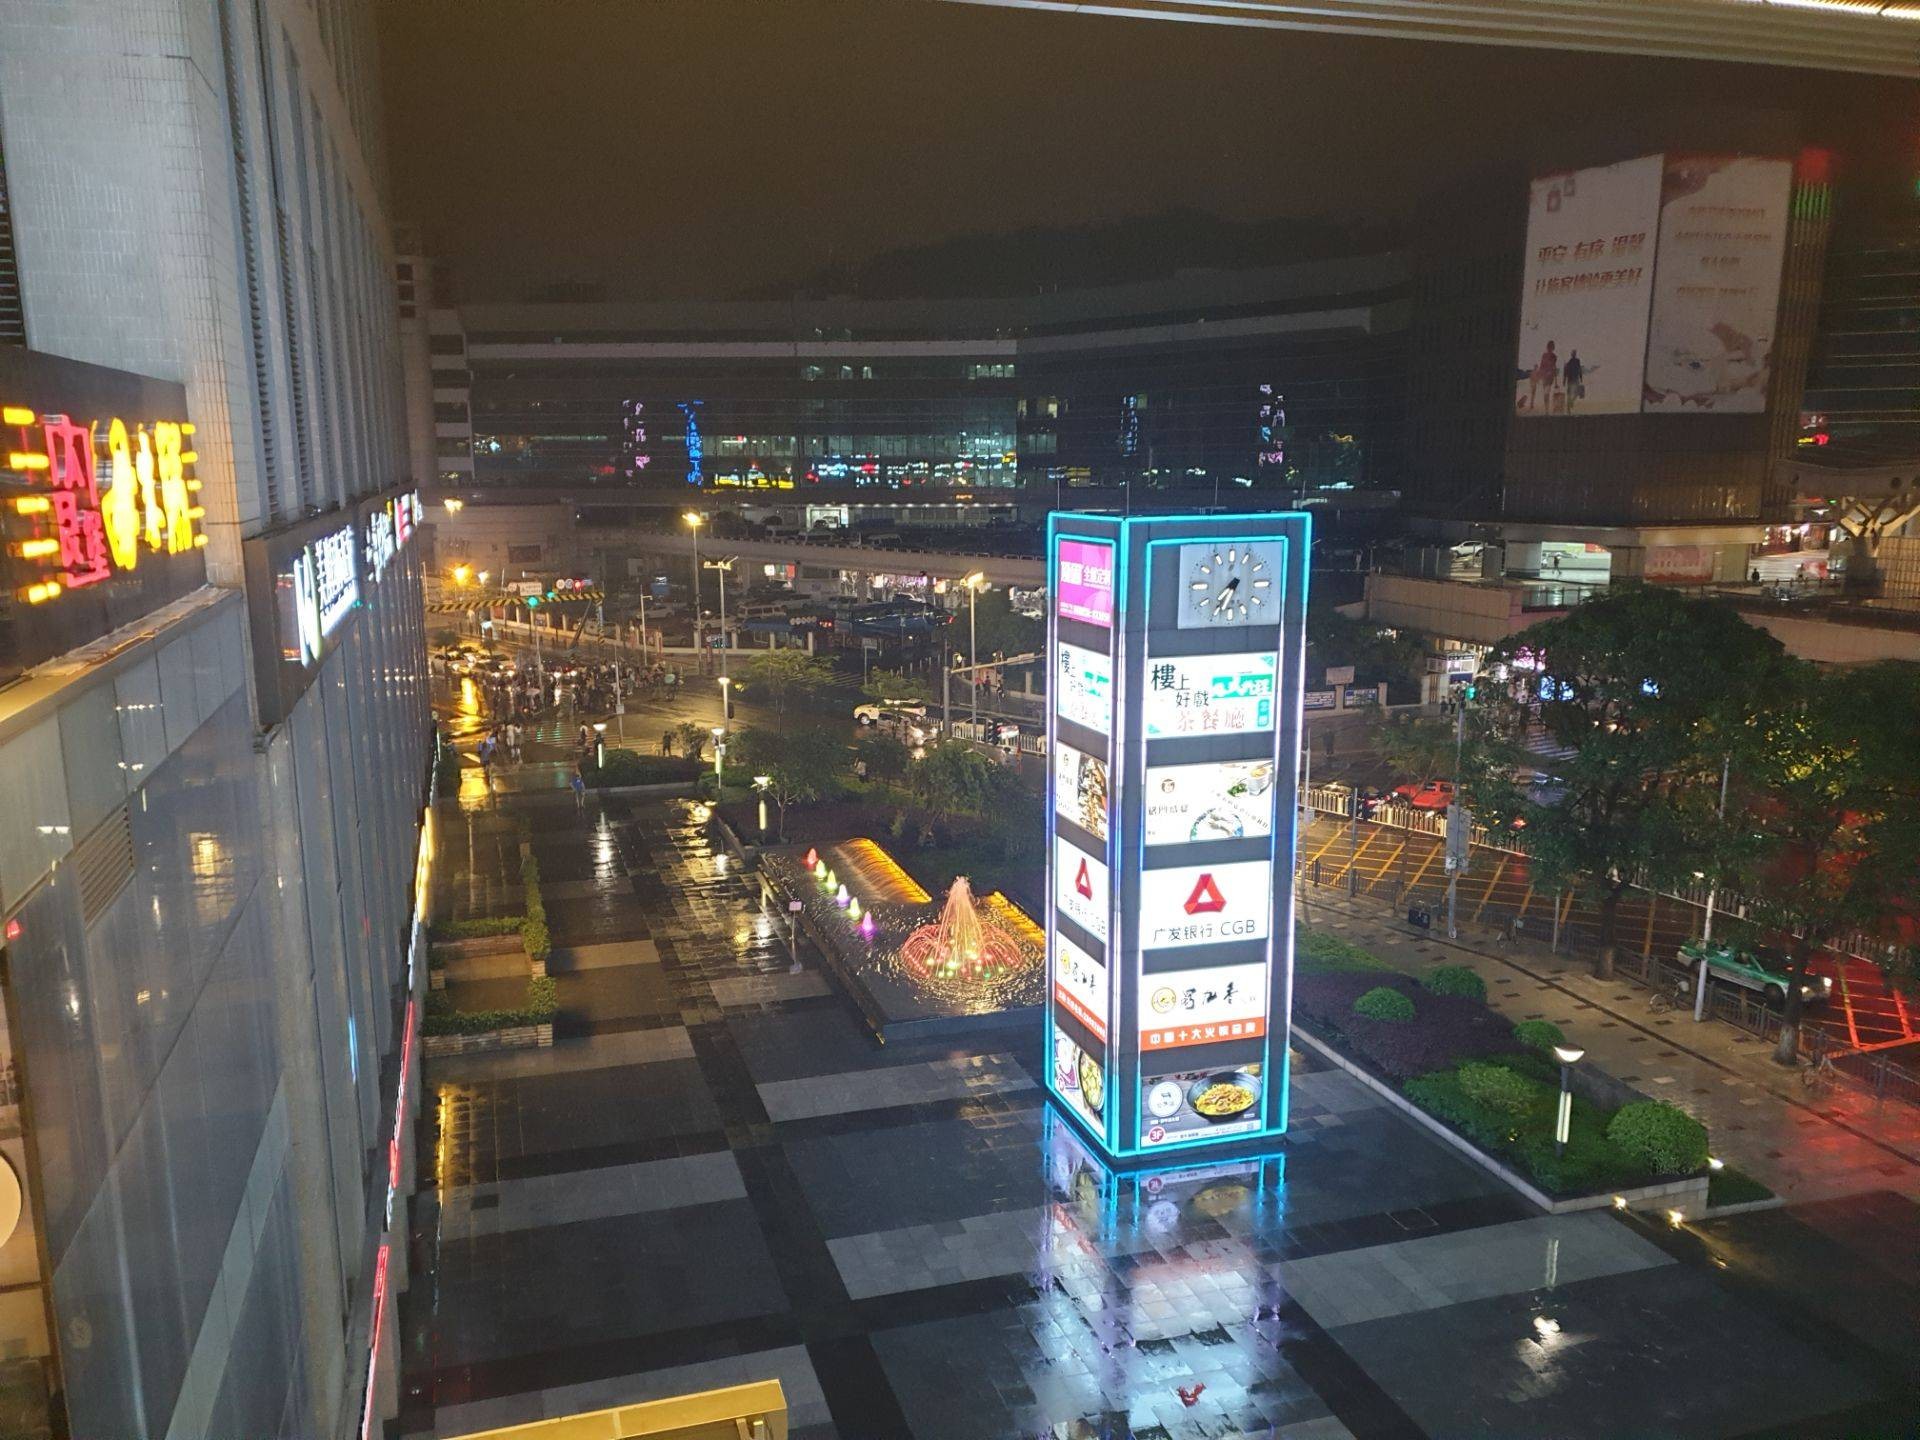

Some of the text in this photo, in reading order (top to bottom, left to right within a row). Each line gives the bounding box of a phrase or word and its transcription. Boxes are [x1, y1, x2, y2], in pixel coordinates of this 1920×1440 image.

[1153, 919, 1256, 944] 广发银行 CGB
